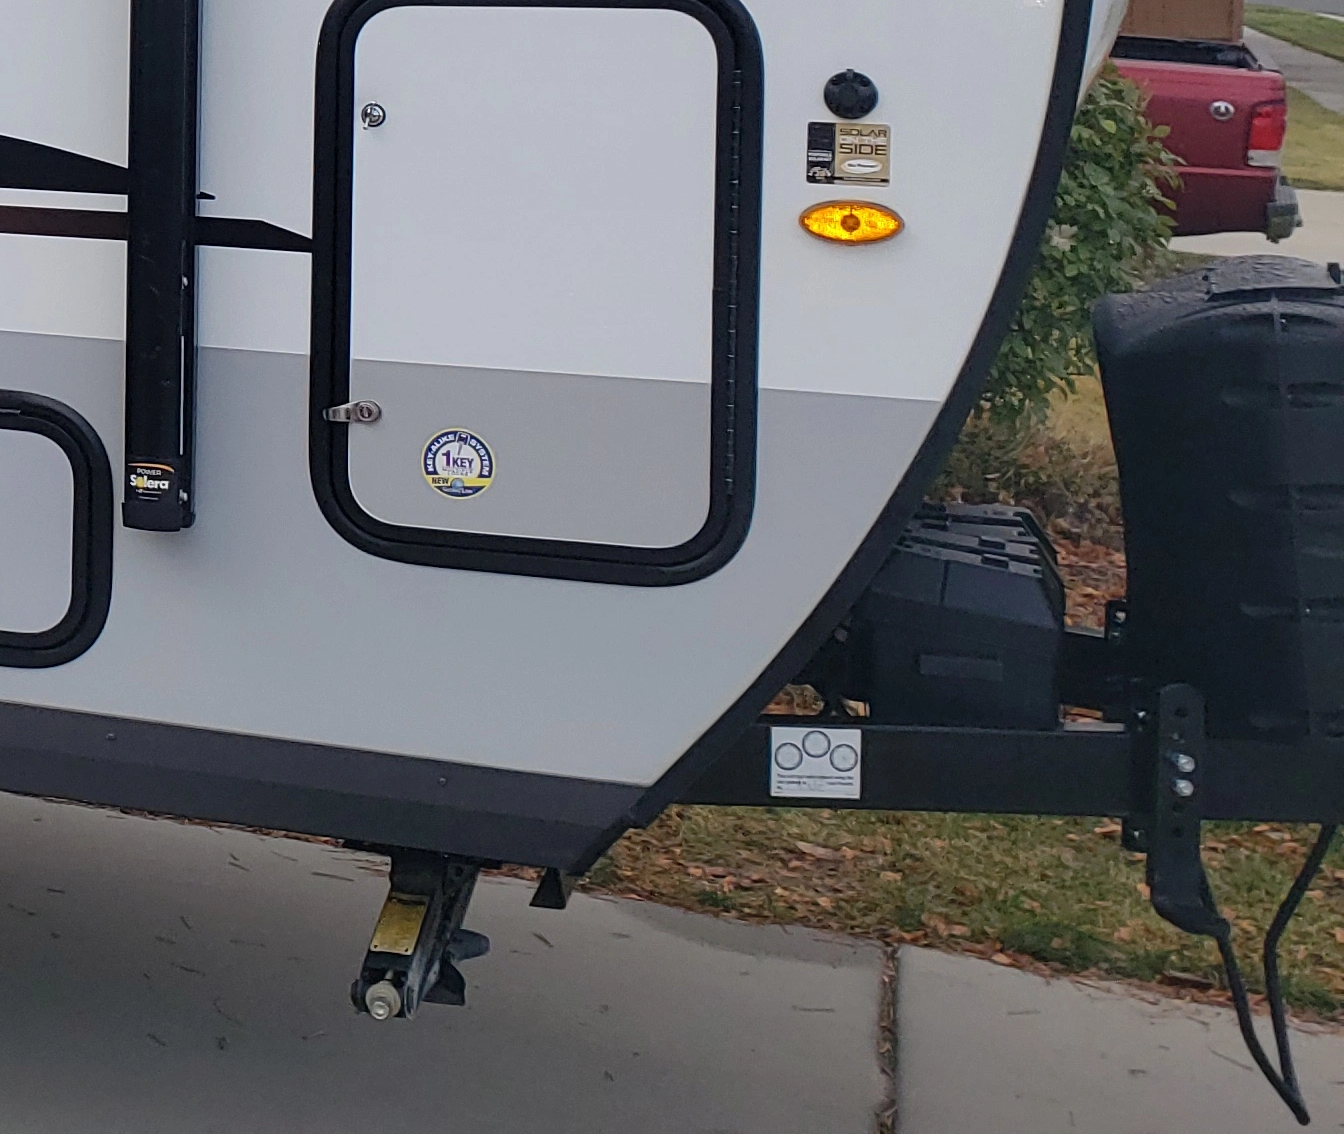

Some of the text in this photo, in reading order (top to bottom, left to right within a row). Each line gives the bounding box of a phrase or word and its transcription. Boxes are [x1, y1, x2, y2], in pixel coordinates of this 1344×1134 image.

[840, 128, 887, 137] SOLAR
[839, 143, 887, 155] SIDE
[469, 438, 490, 476] SYSTEM
[136, 467, 162, 476] POWER
[129, 474, 169, 490] Solera
[431, 477, 449, 485] NEW
